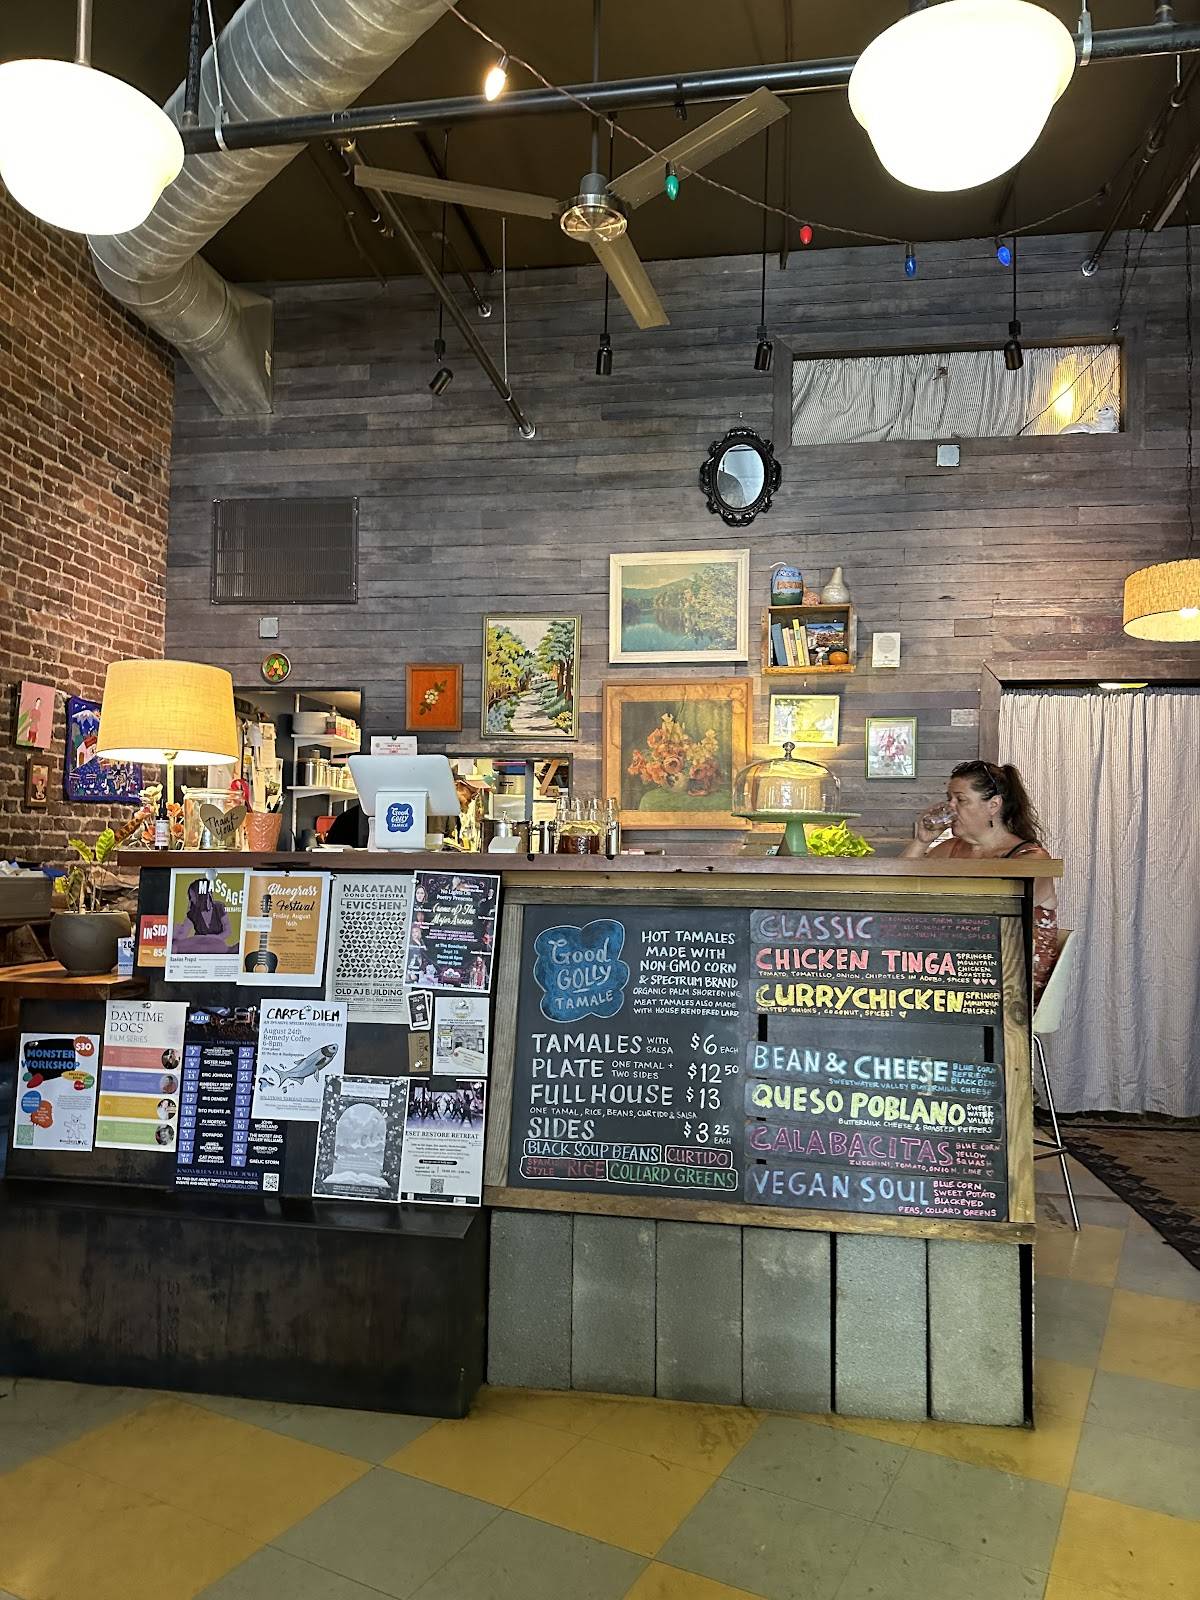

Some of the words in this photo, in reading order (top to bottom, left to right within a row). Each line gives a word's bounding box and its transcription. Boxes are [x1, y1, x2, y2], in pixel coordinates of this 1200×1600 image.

[391, 807, 410, 816] Good
[205, 812, 239, 828] Thank
[268, 883, 319, 902] Bluegrass
[343, 884, 407, 893] NAKATANI
[276, 899, 316, 912] Festival
[346, 901, 402, 910] EVICSHEN
[760, 914, 873, 940] CLASSIC
[641, 930, 670, 943] HOT
[675, 930, 736, 944] TAMALES
[548, 936, 611, 965] Good
[646, 946, 686, 958] MADE
[690, 947, 726, 960] WITH
[755, 947, 869, 971] CHICKEN
[881, 950, 956, 976] TINGA
[704, 962, 737, 974] CORN
[556, 964, 612, 990] GOLLY
[638, 974, 649, 984] &
[650, 974, 702, 987] SPECTRUM
[704, 976, 739, 988] BRAND
[632, 987, 667, 995] ORGANIC
[669, 988, 690, 996] PALM
[692, 988, 742, 998] SHORTENING
[554, 990, 614, 1010] TAMALE
[634, 998, 657, 1006] MEAT
[659, 998, 694, 1006] TAMALES
[714, 1001, 737, 1009] MADE
[111, 1010, 165, 1022] DAYTIME
[267, 1008, 306, 1020] CARPE
[312, 1009, 340, 1022] DIEM
[680, 1008, 720, 1016] RENDERED
[110, 1022, 144, 1034] DOCS
[531, 1032, 643, 1054] TAMALES
[646, 1036, 670, 1045] WITH
[76, 1042, 92, 1052] $30
[646, 1046, 674, 1054] SALSA
[720, 1046, 739, 1054] EACH
[26, 1049, 75, 1058] MONSTER
[21, 1060, 80, 1070] WORKSHOP
[532, 1058, 605, 1079] PLATE
[612, 1060, 631, 1068] ONE
[633, 1060, 665, 1070] TAMAL
[754, 1045, 820, 1074] BEAN
[825, 1052, 848, 1075] &
[854, 1055, 949, 1083] CHEESE
[611, 1070, 630, 1078] TWO
[632, 1070, 659, 1080] SIDES
[951, 1078, 977, 1086] BLACK
[530, 1084, 586, 1106] FULL
[591, 1084, 673, 1106] HOUSE
[751, 1083, 844, 1115] QUESO
[850, 1092, 966, 1126] POBLANO
[966, 1104, 994, 1112] SWEET
[529, 1106, 548, 1114] ONE
[637, 1110, 668, 1118] CURTIDO
[669, 1112, 675, 1120] &
[676, 1112, 697, 1120] SALSA
[527, 1117, 595, 1141] SIDES
[714, 1124, 730, 1136] 25
[838, 1118, 881, 1127] BUTTERMILK
[884, 1121, 912, 1130] CHEESE
[923, 1125, 955, 1133] ROASTED
[957, 1126, 992, 1134] PEPPERS
[451, 1132, 479, 1140] RETREAT
[714, 1137, 732, 1145] EACH
[528, 1141, 573, 1156] BLACK
[574, 1142, 609, 1158] SOUP
[612, 1145, 660, 1162] BEANS
[750, 1126, 953, 1167] CALABACITAS
[956, 1142, 977, 1150] BLUE
[666, 1147, 729, 1166] CURTIDO
[956, 1151, 987, 1159] YELLOW
[610, 1163, 671, 1182] COLLARD
[674, 1168, 736, 1190] GREENS
[752, 1170, 849, 1198] VEGAN
[860, 1176, 929, 1206] SOUL
[933, 1180, 955, 1188] BLUE
[934, 1189, 963, 1197] SWEET
[966, 1191, 996, 1199] POTATO
[934, 1197, 984, 1207] BLACKEYED
[925, 1207, 961, 1215] COLLARD
[963, 1208, 997, 1217] GREENS
